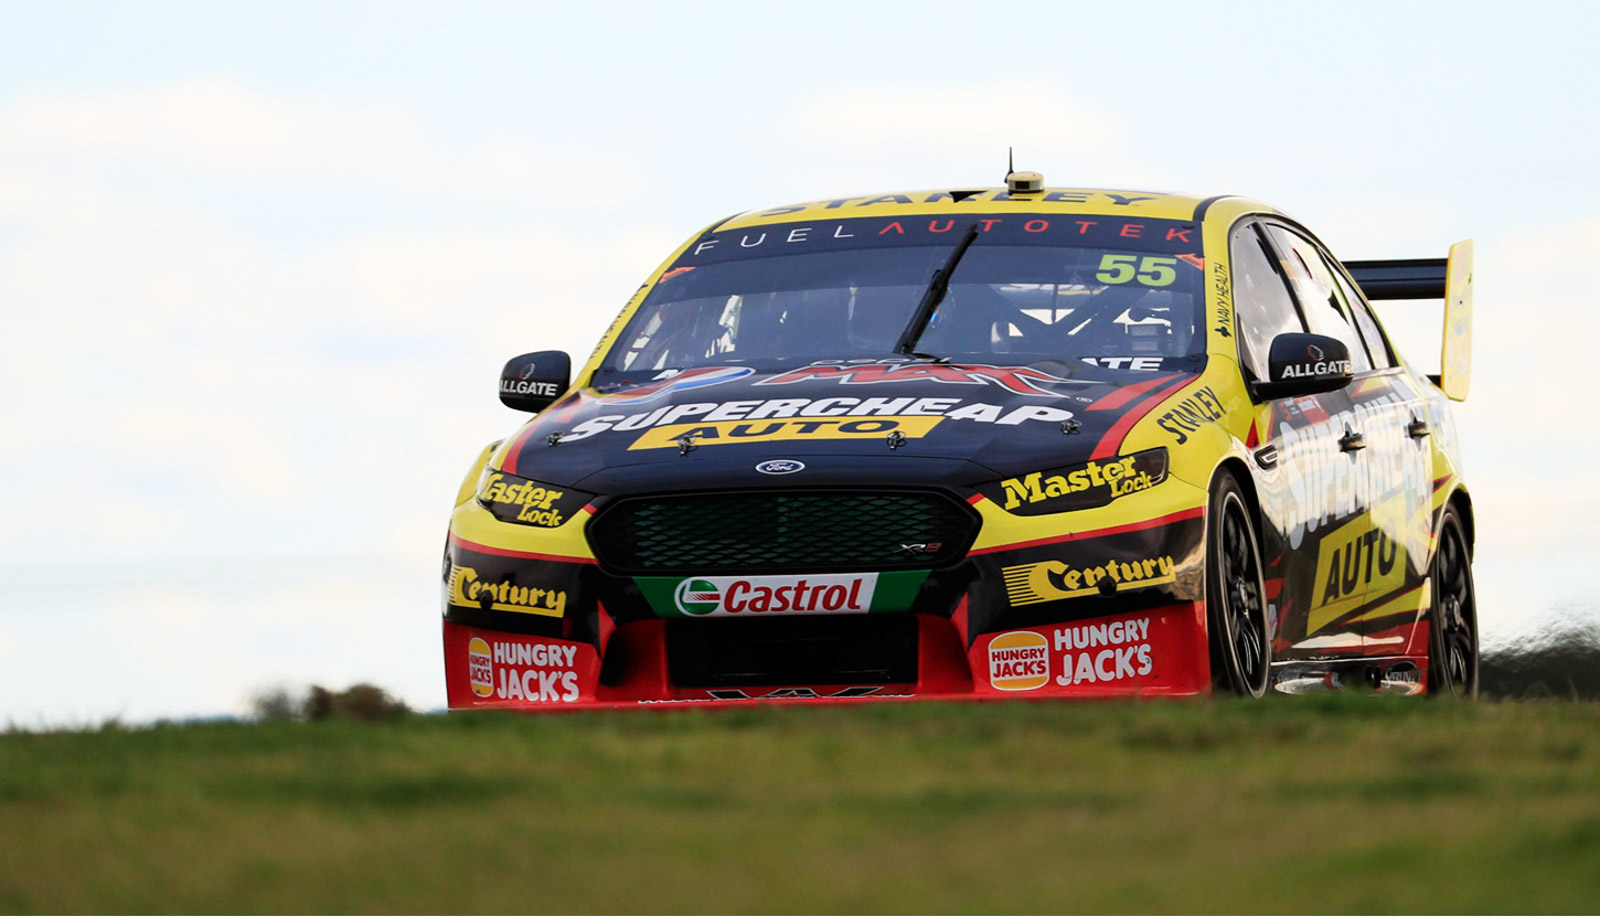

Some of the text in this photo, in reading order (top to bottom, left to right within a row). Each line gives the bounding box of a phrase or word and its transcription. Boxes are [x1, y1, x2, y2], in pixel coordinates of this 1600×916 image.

[694, 218, 1193, 255] FUEL AUTOTEK
[1096, 254, 1177, 287] 55
[1214, 263, 1230, 326] NAVY HEALTH
[1281, 360, 1352, 379] ALLGATE
[558, 398, 1074, 443] SUPERCHEAP
[668, 418, 898, 441] AUTO
[1157, 386, 1227, 445] STANLEY
[1001, 456, 1136, 510] Master
[1108, 471, 1153, 498] Lock
[517, 503, 563, 526] Lock
[1321, 520, 1397, 607] AUTO
[449, 565, 567, 618] Century
[723, 578, 863, 613] Castrol
[1002, 555, 1176, 607] Century
[1054, 617, 1150, 651] HUNGRY
[493, 641, 578, 667] HUNGRY
[992, 648, 1045, 662] HUNGRY
[993, 660, 1047, 678] JACK'S
[1056, 643, 1153, 686] JACK'S
[497, 668, 580, 702] JACK'S
